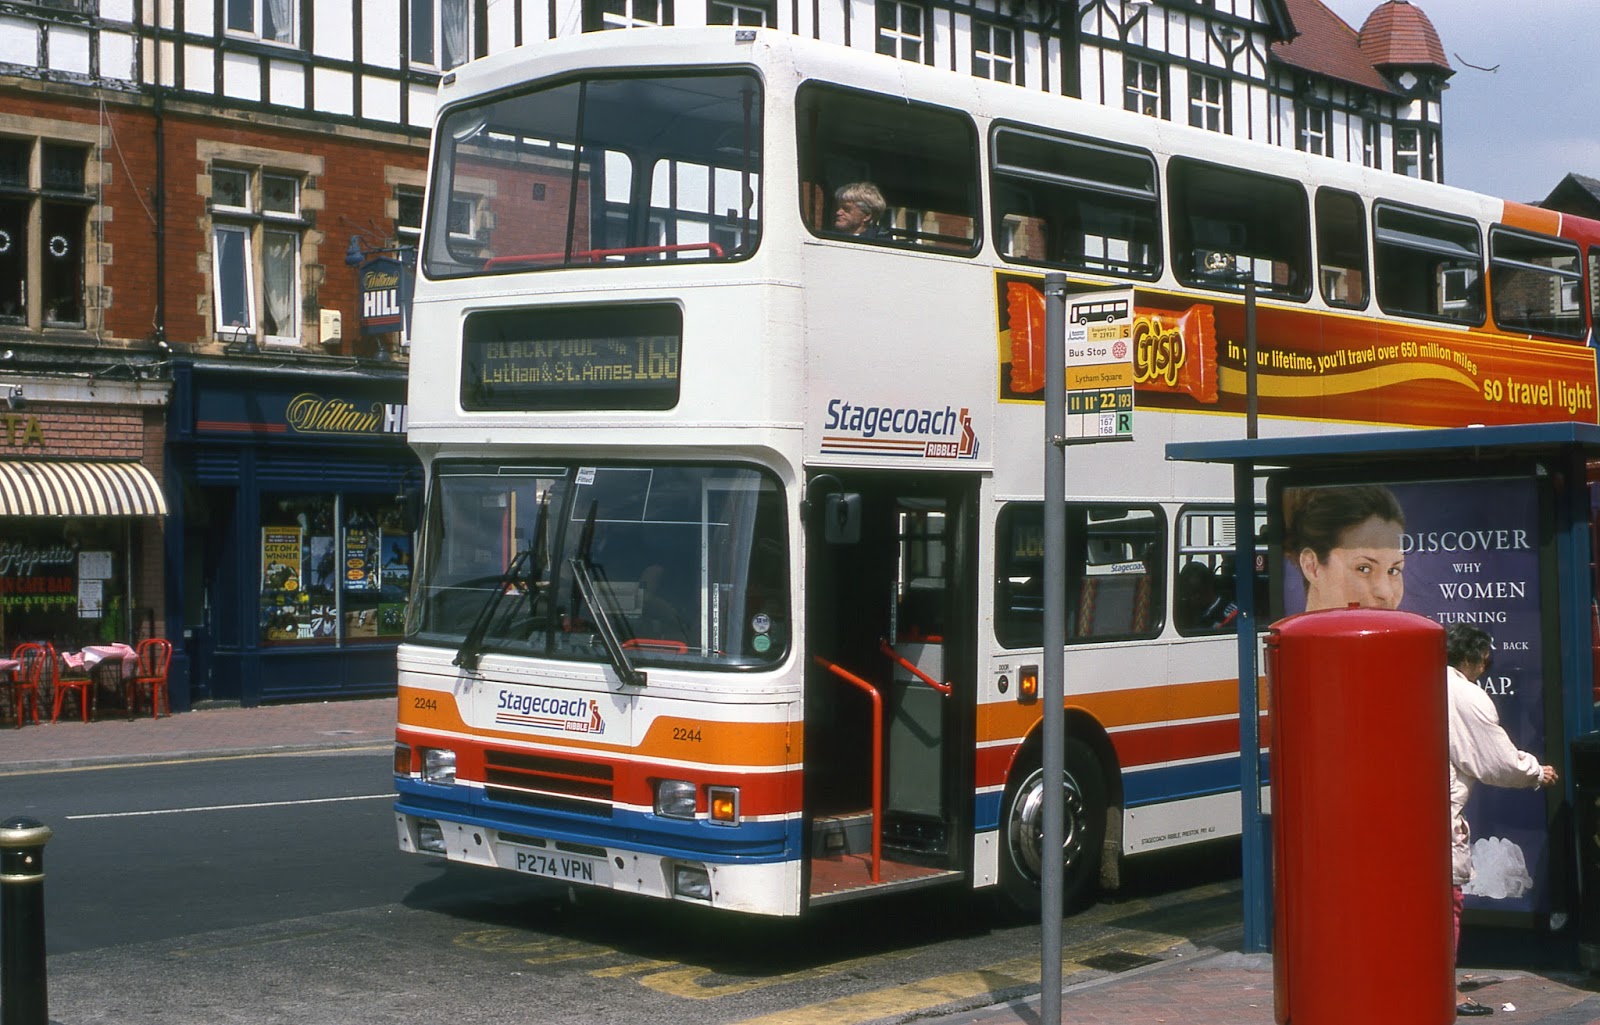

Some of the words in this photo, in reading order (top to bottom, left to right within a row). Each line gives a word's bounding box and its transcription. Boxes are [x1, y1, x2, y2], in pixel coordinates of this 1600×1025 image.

[364, 271, 399, 290] William
[363, 289, 400, 318] HILL
[1123, 328, 1129, 338] S
[486, 338, 598, 359] BLACKPOOL
[1069, 349, 1084, 357] Bus
[1087, 347, 1107, 357] Stop
[1134, 319, 1184, 386] Crisp
[633, 334, 679, 380] 168
[1228, 340, 1240, 360] in
[1242, 347, 1269, 366] yur
[1272, 350, 1316, 373] lifetime,
[1317, 349, 1346, 374] you'll
[1348, 345, 1376, 365] travel
[1377, 345, 1399, 360] over
[1400, 341, 1418, 358] 650
[1419, 342, 1451, 361] million
[1453, 350, 1478, 376] miles
[1075, 373, 1100, 384] Lytham
[1100, 372, 1122, 383] Square
[1100, 392, 1116, 409] 22
[1118, 393, 1132, 408] 193
[1483, 378, 1503, 402] so
[1507, 376, 1553, 406] travel
[1558, 380, 1592, 415] light
[286, 393, 385, 432] William
[384, 403, 408, 433] HI
[824, 398, 957, 438] Stagecoach
[1100, 418, 1113, 426] 167
[1118, 413, 1130, 431] R
[1100, 426, 1113, 435] 168
[927, 444, 957, 456] RIBBLE
[264, 544, 279, 552] GET
[280, 544, 292, 552] ON
[1398, 529, 1531, 552] DISCOVER
[265, 552, 298, 560] WINNER
[1110, 562, 1145, 573] Stagecoac
[1452, 562, 1482, 573] WHY
[1438, 582, 1526, 599] WOMEN
[1437, 611, 1507, 624] TURNING
[1503, 641, 1529, 650] BACK
[1477, 676, 1515, 696] AP.
[414, 697, 437, 710] 2244
[497, 689, 587, 718] Stagecoach
[566, 721, 588, 732] RIBBLE
[673, 727, 702, 743] 2244
[1141, 834, 1167, 844] STAGECOACH
[517, 852, 558, 876] P274
[561, 857, 593, 881] VPN
